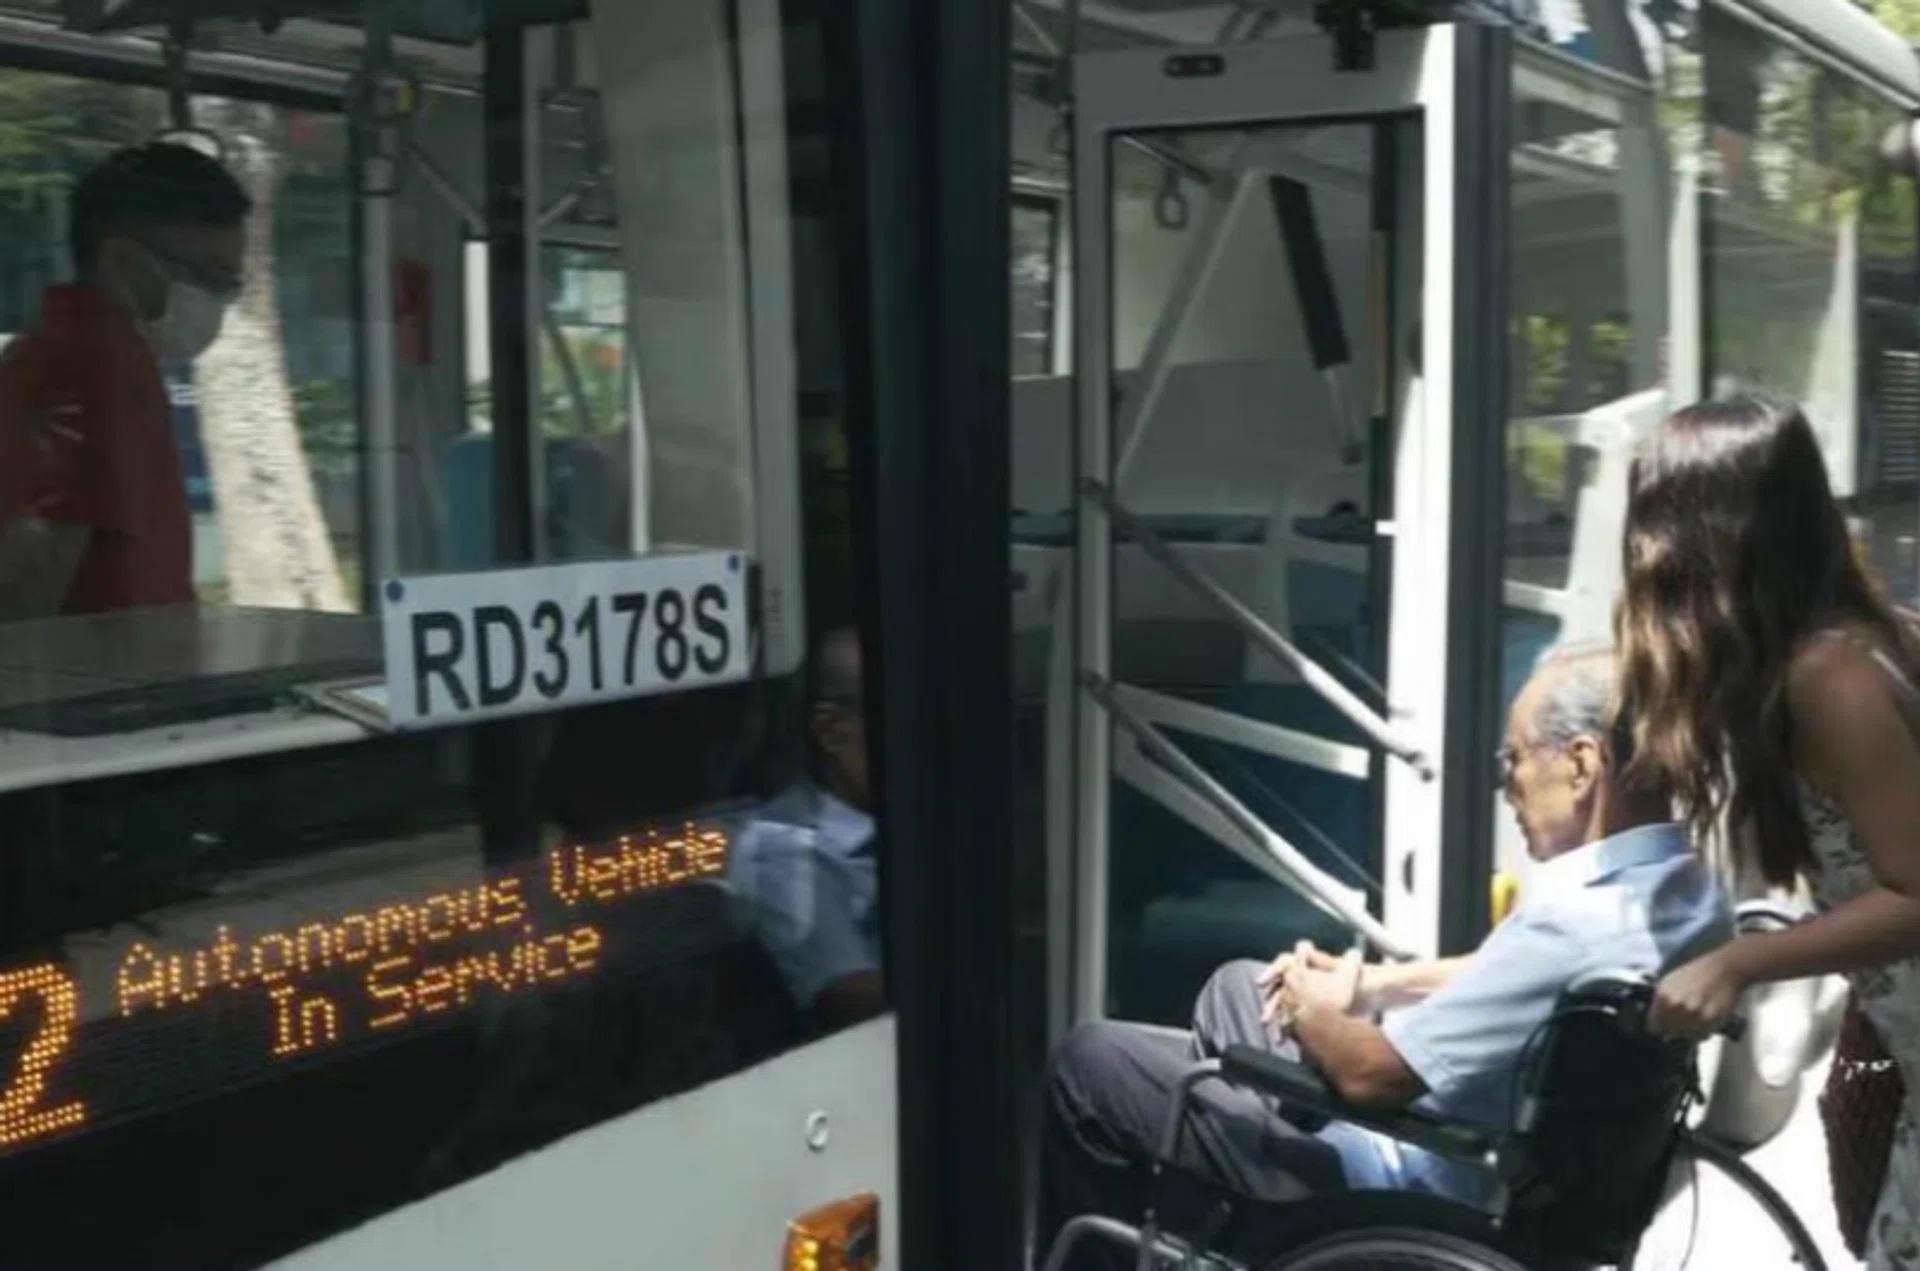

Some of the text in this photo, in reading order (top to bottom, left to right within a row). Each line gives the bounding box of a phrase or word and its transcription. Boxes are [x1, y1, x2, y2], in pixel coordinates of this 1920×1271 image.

[411, 583, 730, 716] RD3178S
[117, 821, 728, 1017] Autonomous Vehicle
[263, 925, 601, 1055] In Service
